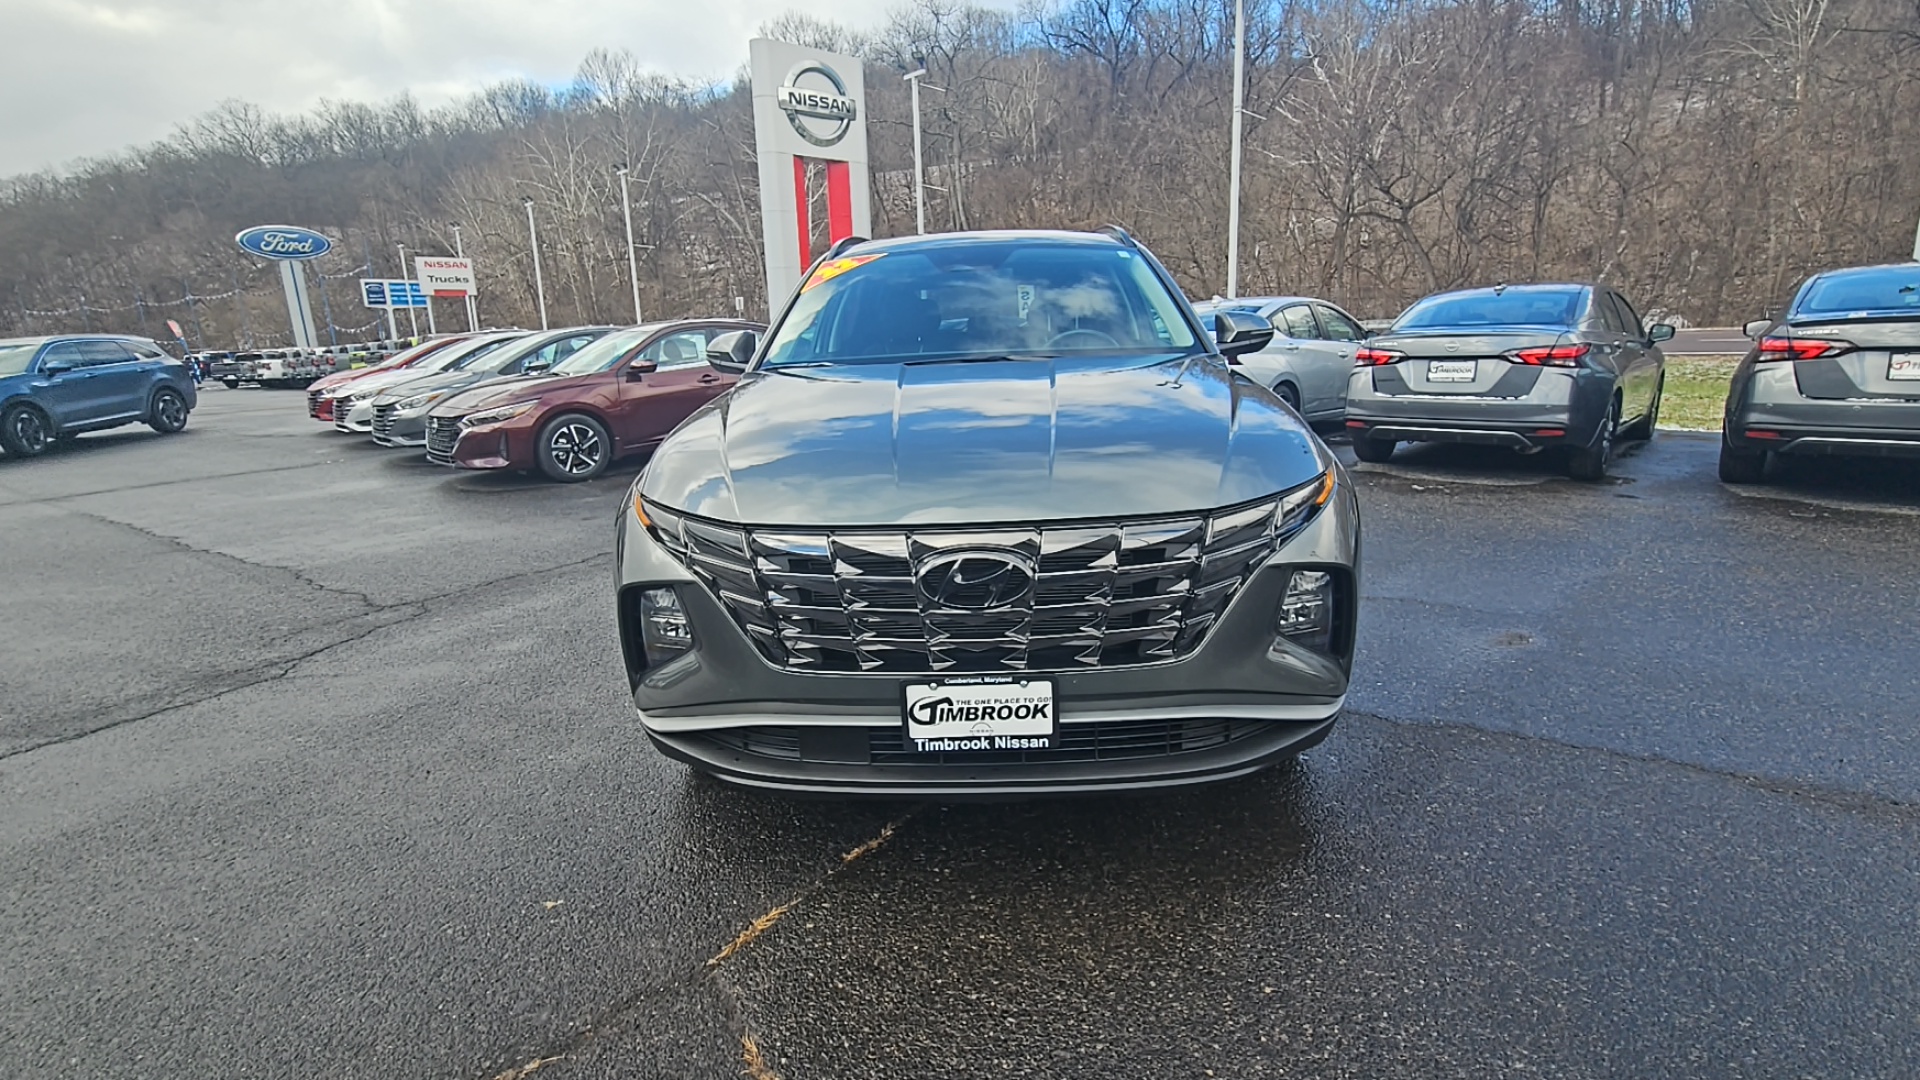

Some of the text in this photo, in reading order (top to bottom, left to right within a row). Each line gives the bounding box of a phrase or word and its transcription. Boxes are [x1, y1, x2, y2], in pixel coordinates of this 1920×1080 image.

[788, 91, 851, 114] NISSAN
[260, 231, 314, 253] Ford
[423, 260, 468, 270] NISSAN
[427, 274, 470, 285] Trucks
[984, 676, 1012, 684] Maryland
[993, 697, 1020, 705] PLACE
[908, 696, 1050, 726] TIMBROOK
[914, 736, 1049, 751] Timbrook Nissan
